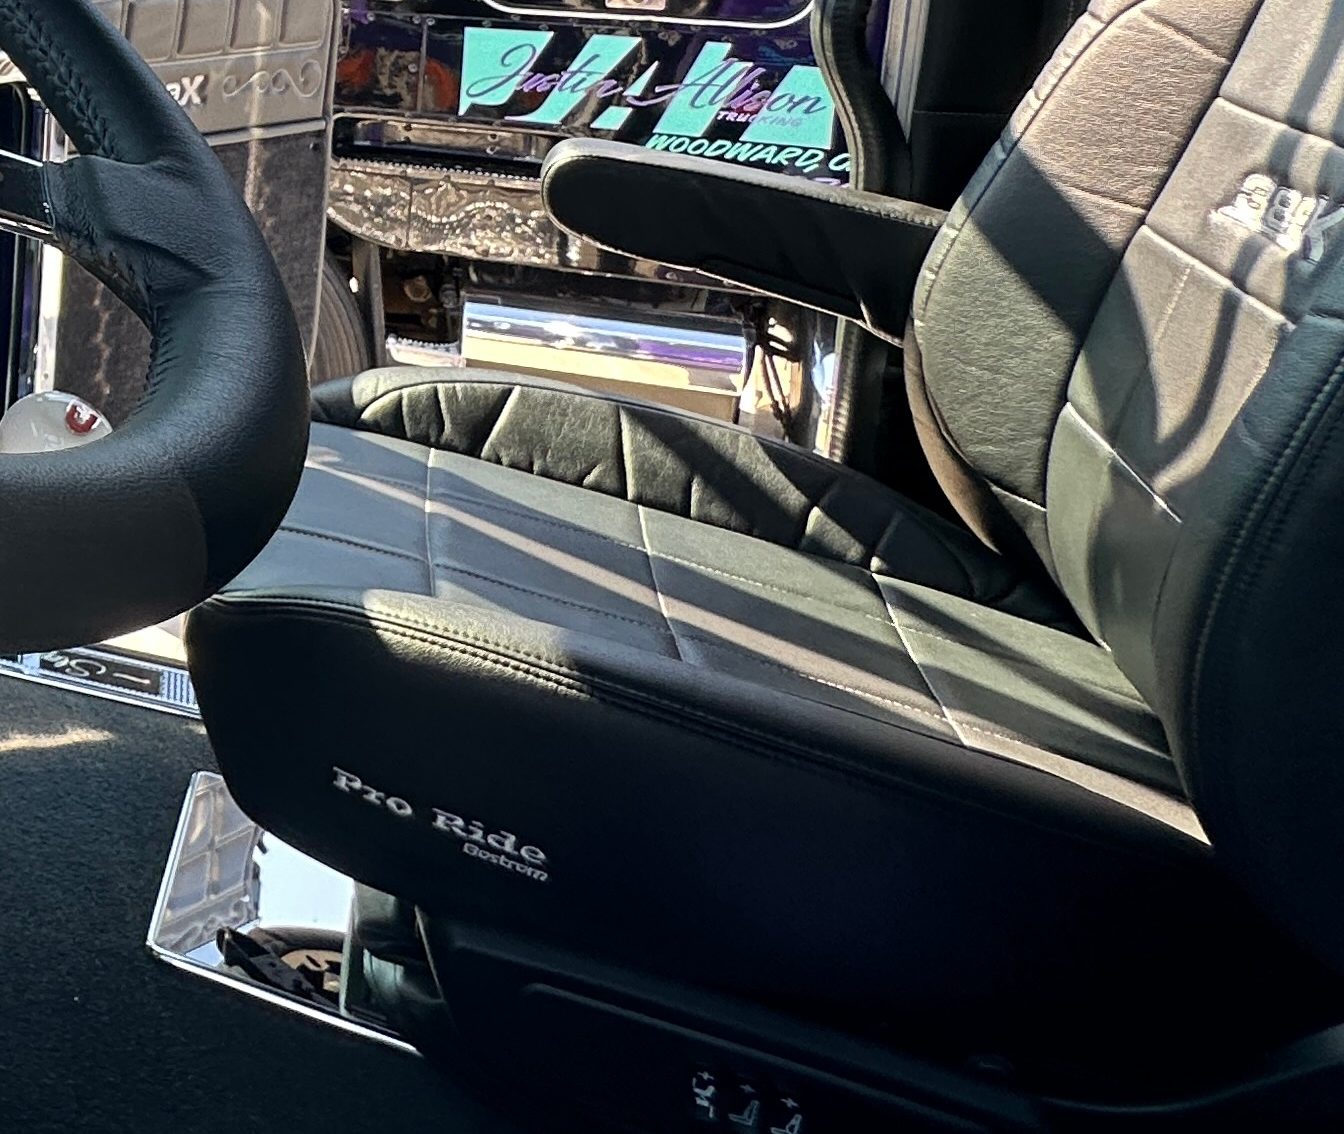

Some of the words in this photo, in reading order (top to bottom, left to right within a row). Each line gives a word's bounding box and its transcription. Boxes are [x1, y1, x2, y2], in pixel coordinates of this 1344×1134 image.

[466, 43, 624, 99] Justin
[716, 110, 803, 128] TRUCKING
[332, 766, 413, 817] Pro
[431, 807, 547, 866] Ride
